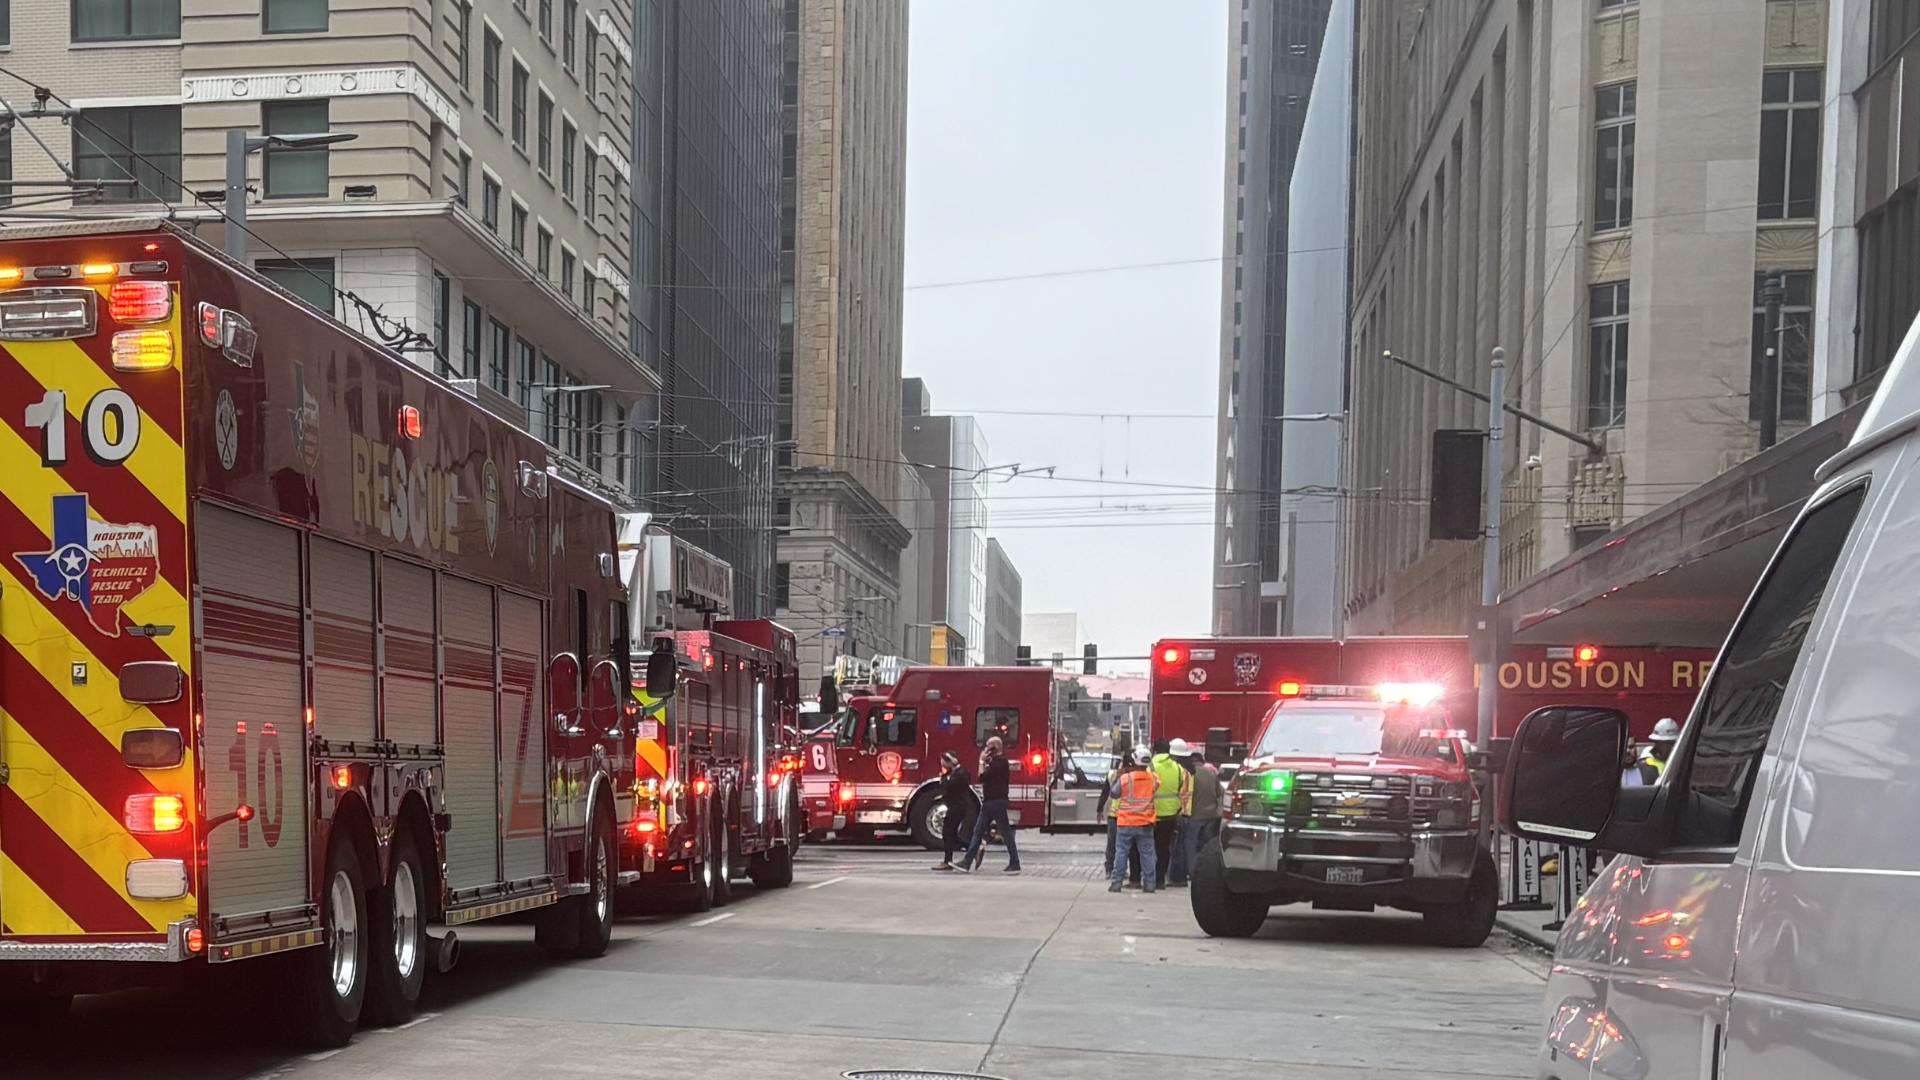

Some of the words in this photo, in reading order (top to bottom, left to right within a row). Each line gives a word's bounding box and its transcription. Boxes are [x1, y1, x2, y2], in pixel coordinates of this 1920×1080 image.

[25, 388, 141, 467] 10
[353, 433, 459, 554] RESCUE
[93, 531, 144, 542] HOUSTON
[90, 580, 133, 592] RESCUE
[91, 567, 148, 578] TECHNICAL
[92, 594, 123, 605] TEAM
[811, 744, 827, 771] 6
[228, 721, 283, 848] 10
[1574, 847, 1583, 896] VALE
